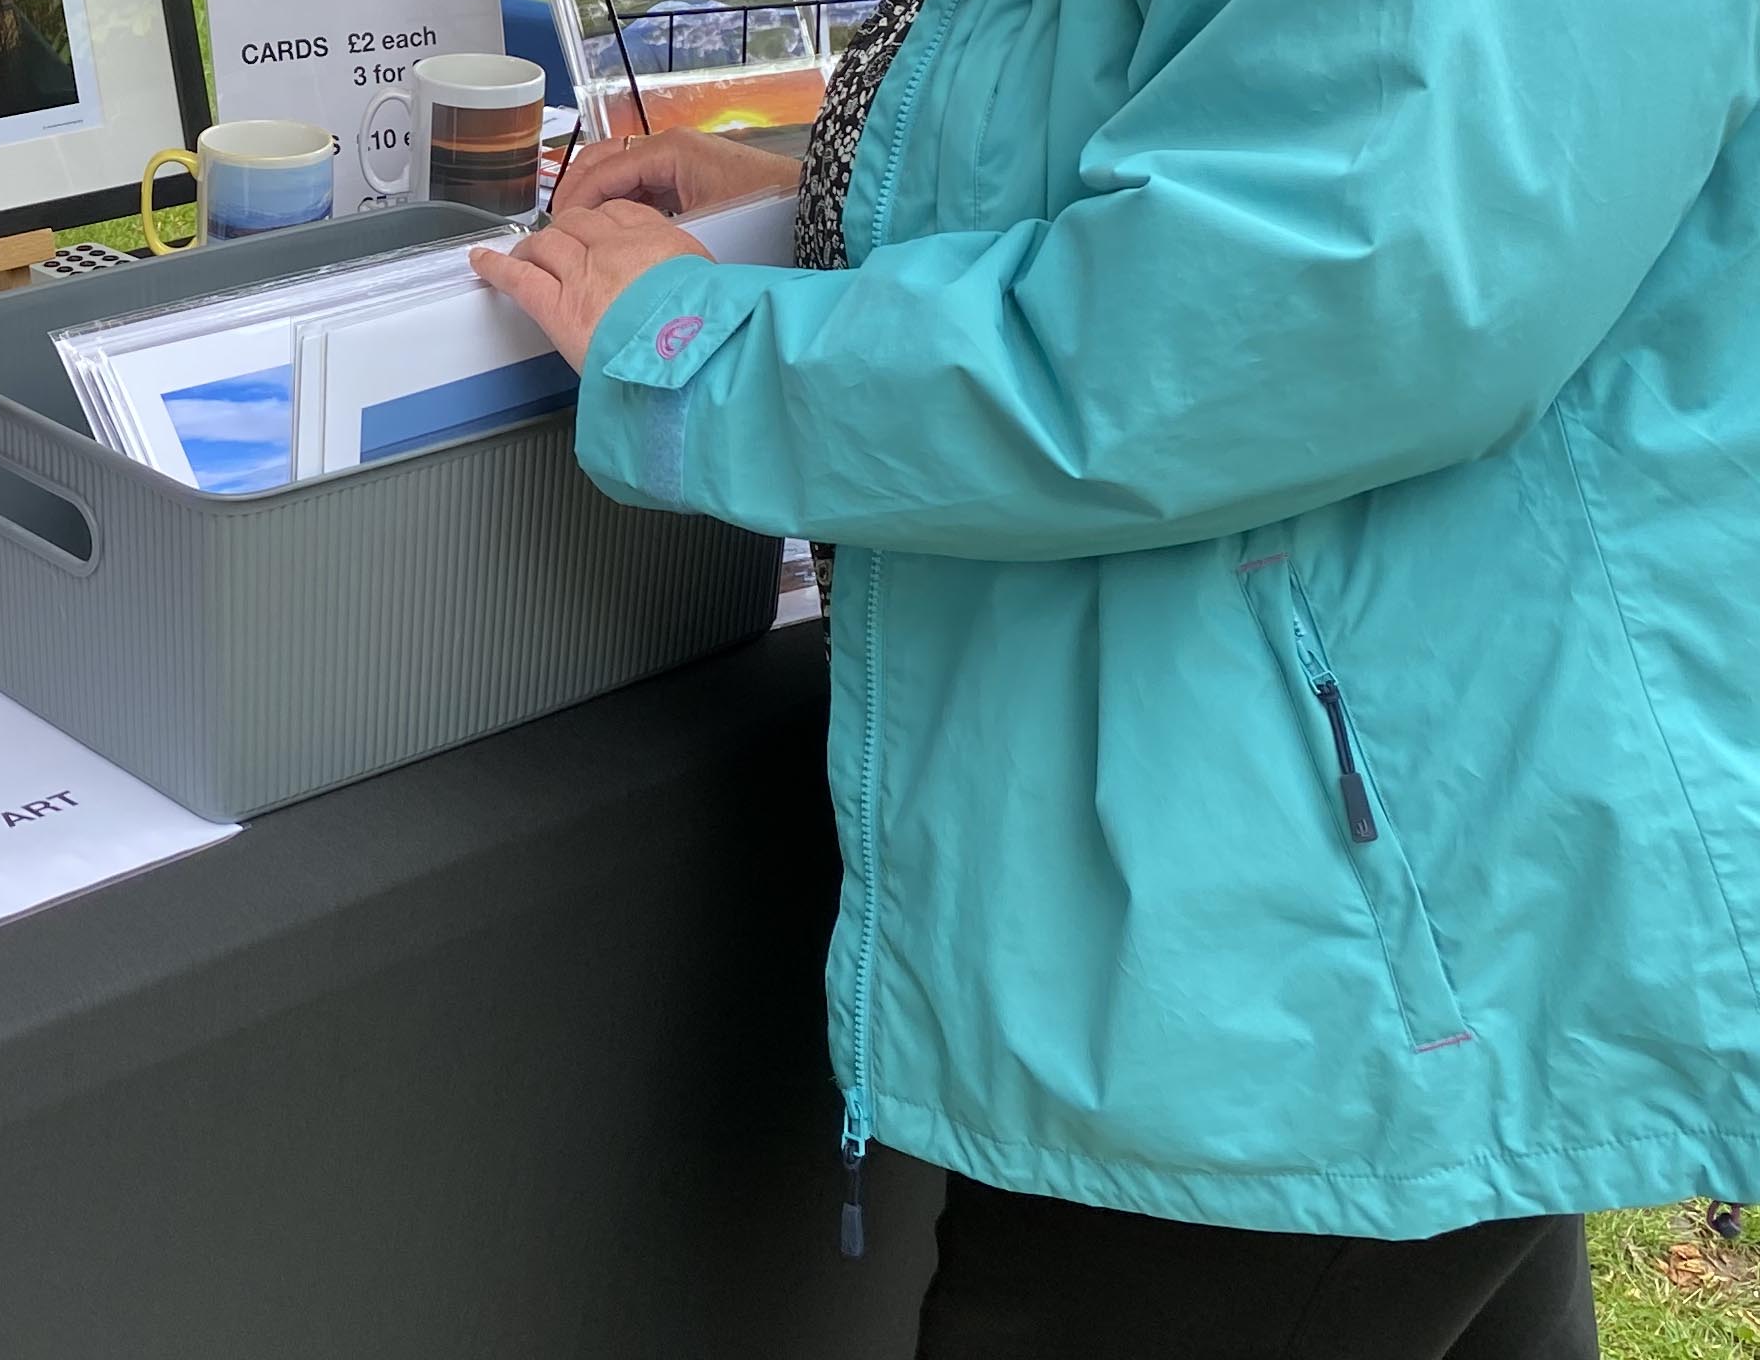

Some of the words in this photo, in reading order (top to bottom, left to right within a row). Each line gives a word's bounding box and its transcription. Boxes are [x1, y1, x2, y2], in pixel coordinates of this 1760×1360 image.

[241, 36, 329, 65] CARDS
[347, 32, 375, 53] £2
[382, 26, 437, 50] each
[353, 66, 367, 86] 3
[373, 64, 406, 84] for
[359, 128, 396, 151] 10
[1, 790, 81, 828] ART
